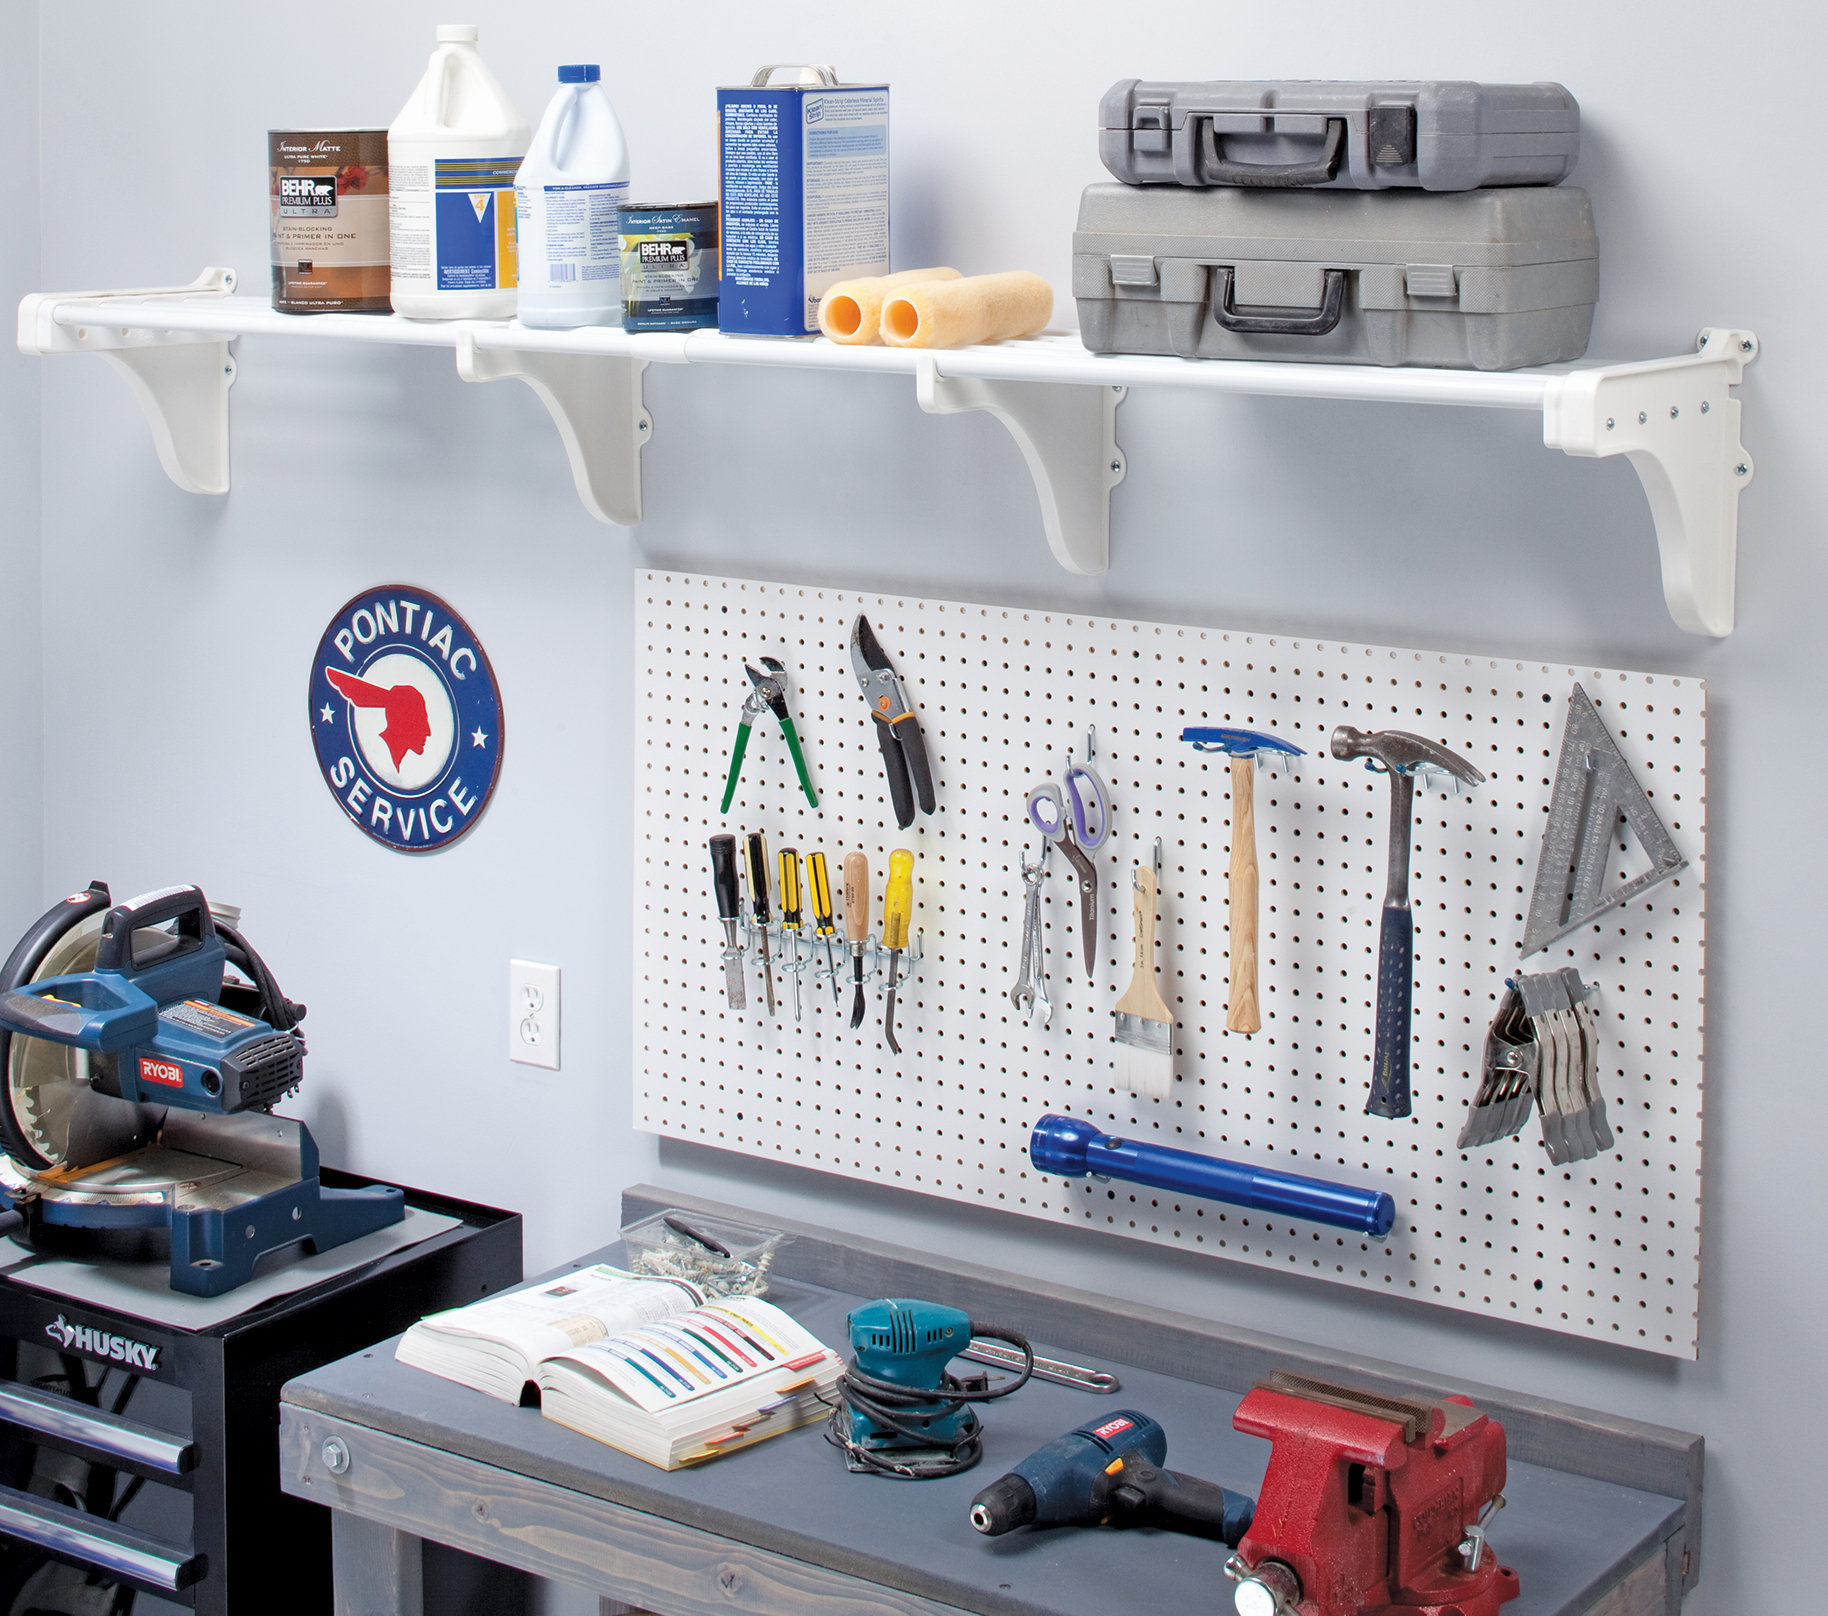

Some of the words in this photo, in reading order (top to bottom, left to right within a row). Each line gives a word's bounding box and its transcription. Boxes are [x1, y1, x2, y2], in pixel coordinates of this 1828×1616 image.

[807, 104, 822, 113] Klean
[808, 111, 821, 119] Strip
[276, 140, 307, 152] INTERIOR
[309, 139, 341, 152] MATTE
[281, 179, 315, 196] BEHR
[281, 197, 311, 205] PREMIUM
[313, 196, 333, 205] PLUS
[475, 199, 485, 211] 4
[641, 243, 671, 256] BEHR
[334, 599, 477, 680] PONTIAC
[330, 756, 479, 841] SERVICE
[142, 1061, 179, 1081] RYOBI
[74, 1324, 158, 1370] HUSKY
[1095, 1418, 1129, 1435] RYOBI
